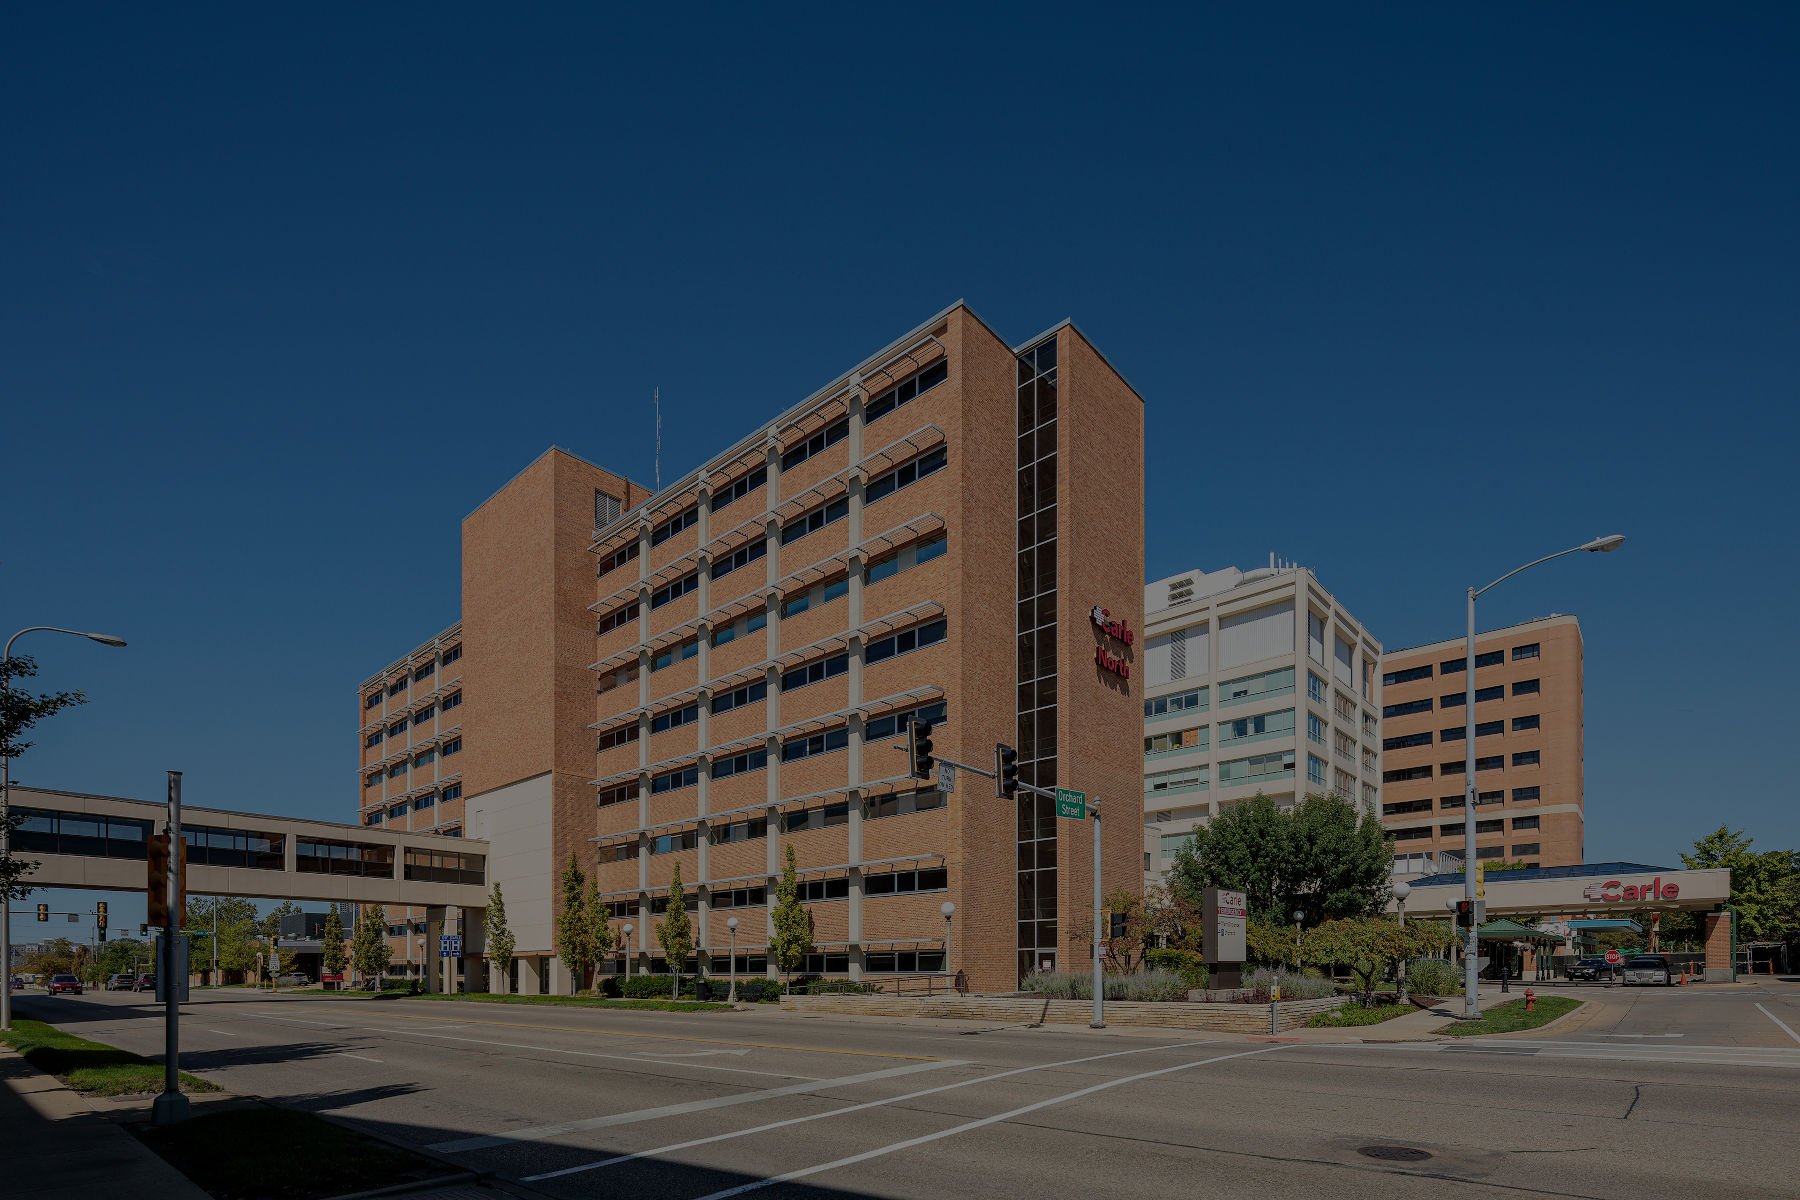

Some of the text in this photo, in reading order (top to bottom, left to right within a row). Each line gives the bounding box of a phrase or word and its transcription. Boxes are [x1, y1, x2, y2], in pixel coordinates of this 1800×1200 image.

[1102, 609, 1134, 646] Carle
[1097, 646, 1129, 679] North
[1058, 790, 1083, 804] Orchard
[1061, 803, 1080, 817] Street
[1601, 877, 1680, 900] Carle
[1225, 892, 1242, 906] Carle
